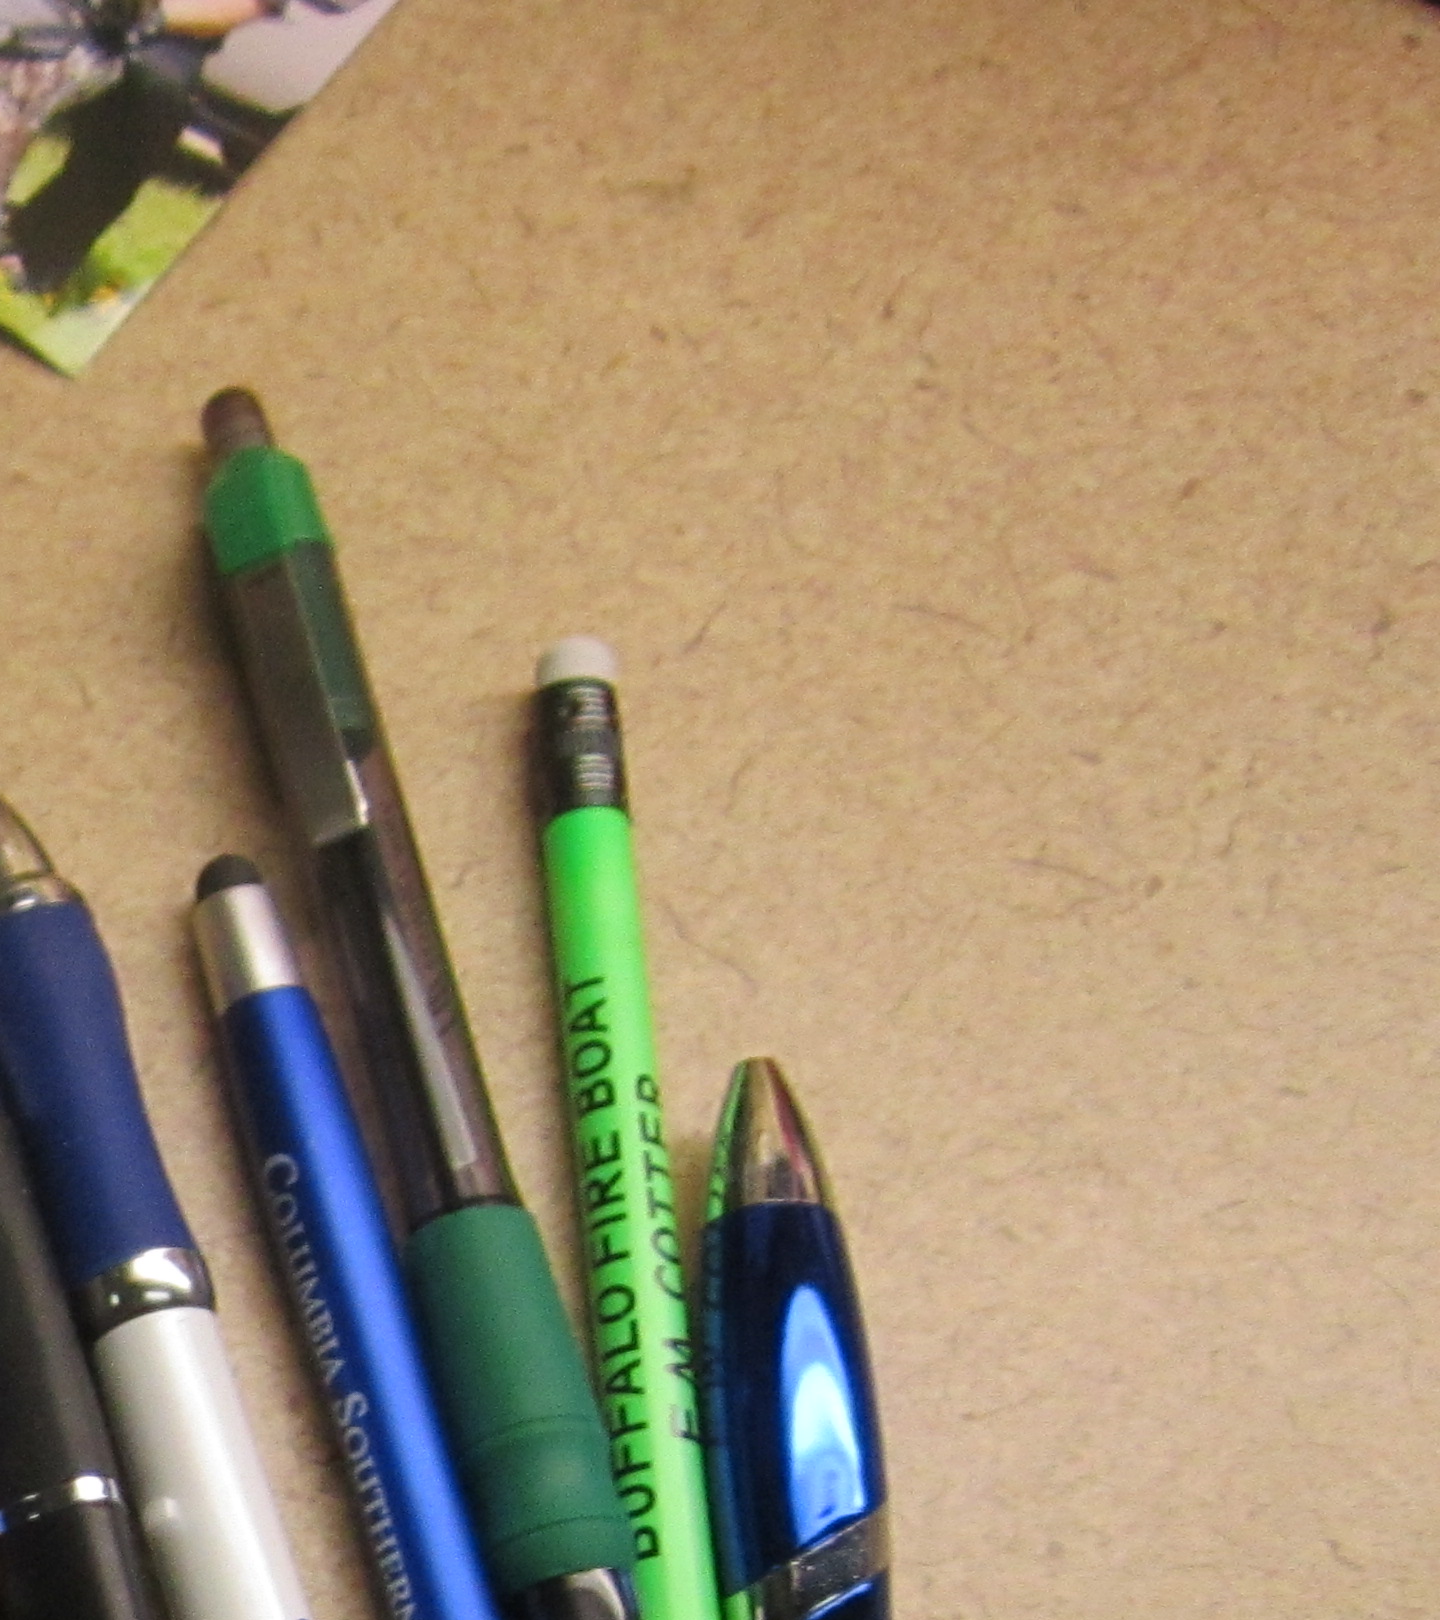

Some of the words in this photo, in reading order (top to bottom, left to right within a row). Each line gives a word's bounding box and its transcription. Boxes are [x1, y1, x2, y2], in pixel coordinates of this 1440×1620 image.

[561, 976, 614, 1114] BOAT
[583, 1129, 629, 1266] FIRE
[605, 1285, 662, 1560] BUFFALO
